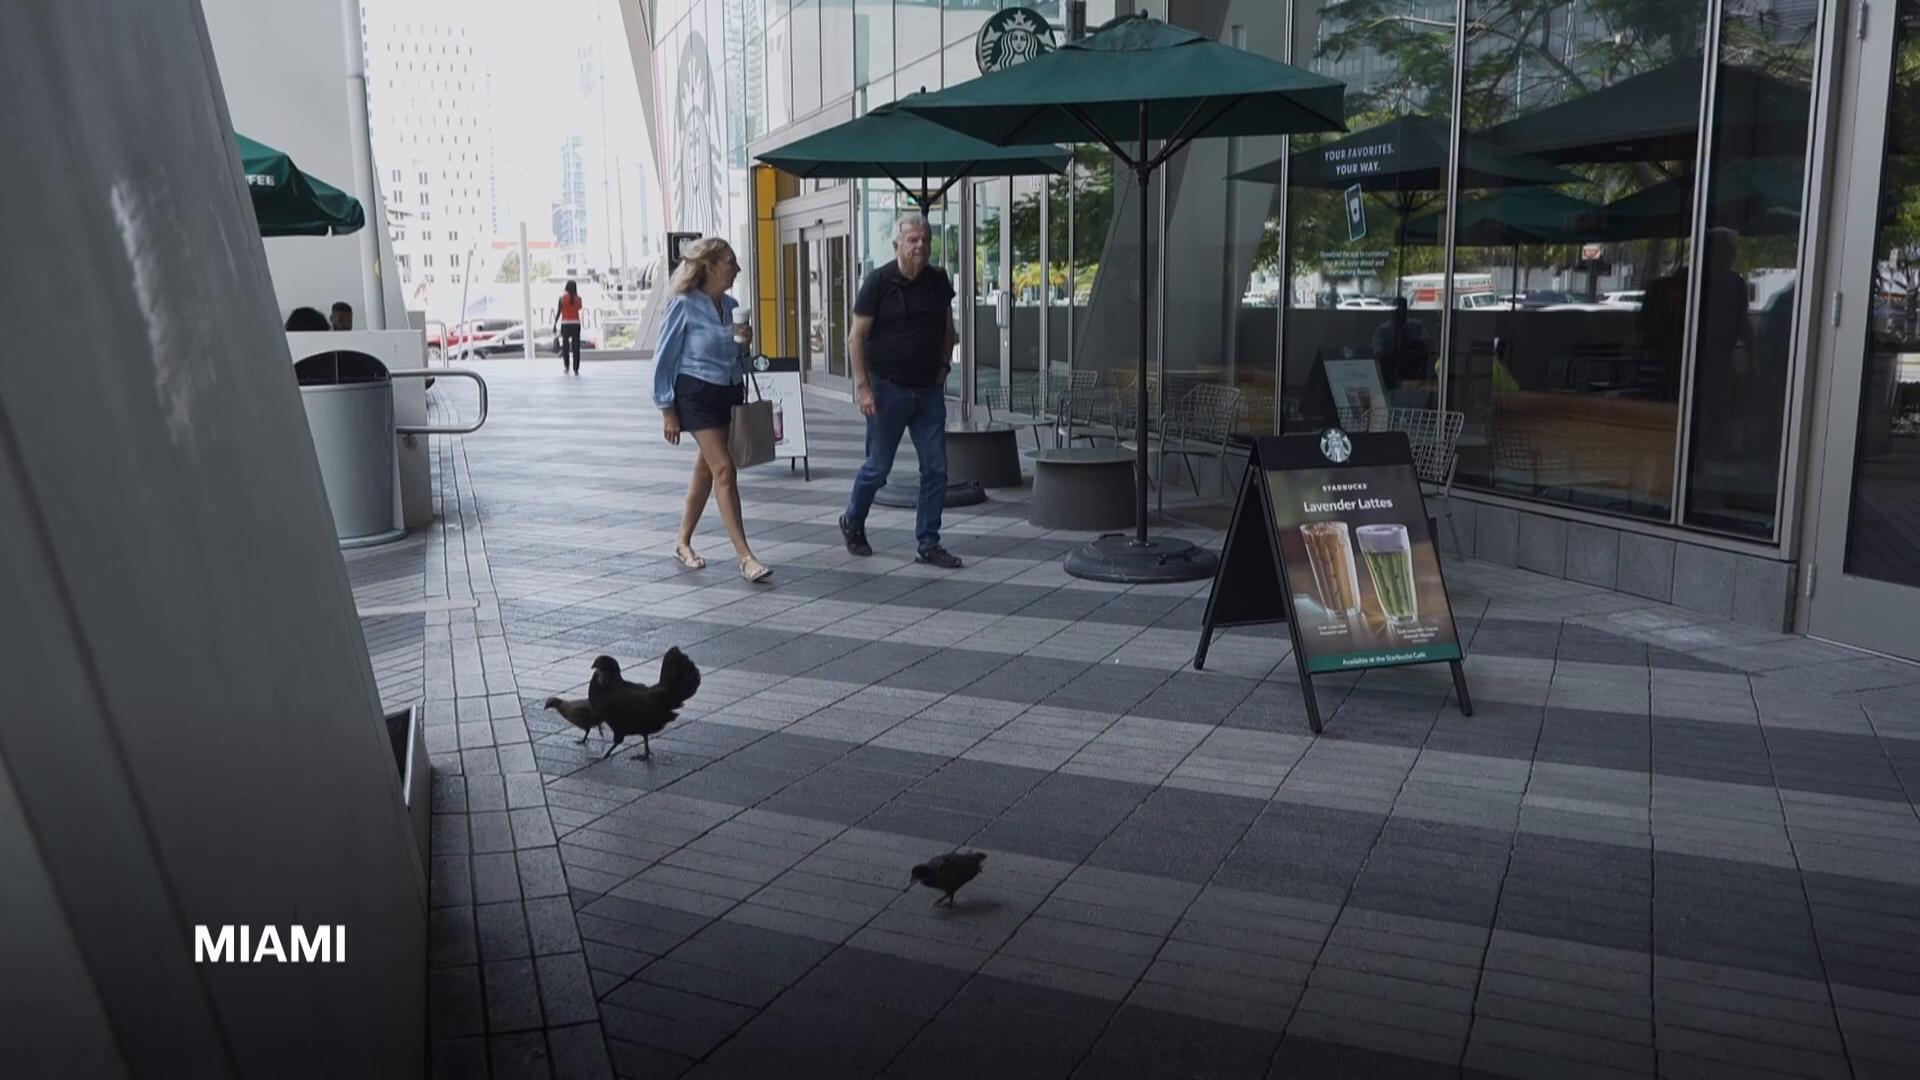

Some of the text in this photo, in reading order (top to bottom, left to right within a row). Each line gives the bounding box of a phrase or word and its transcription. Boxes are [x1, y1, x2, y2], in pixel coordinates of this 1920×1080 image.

[1324, 143, 1395, 162] YOUR FAVORITES.
[1336, 161, 1380, 176] YOUR WAY.
[245, 174, 275, 186] FEE
[1322, 483, 1367, 492] STARBUCKS
[1303, 498, 1393, 513] Lavender Lattes
